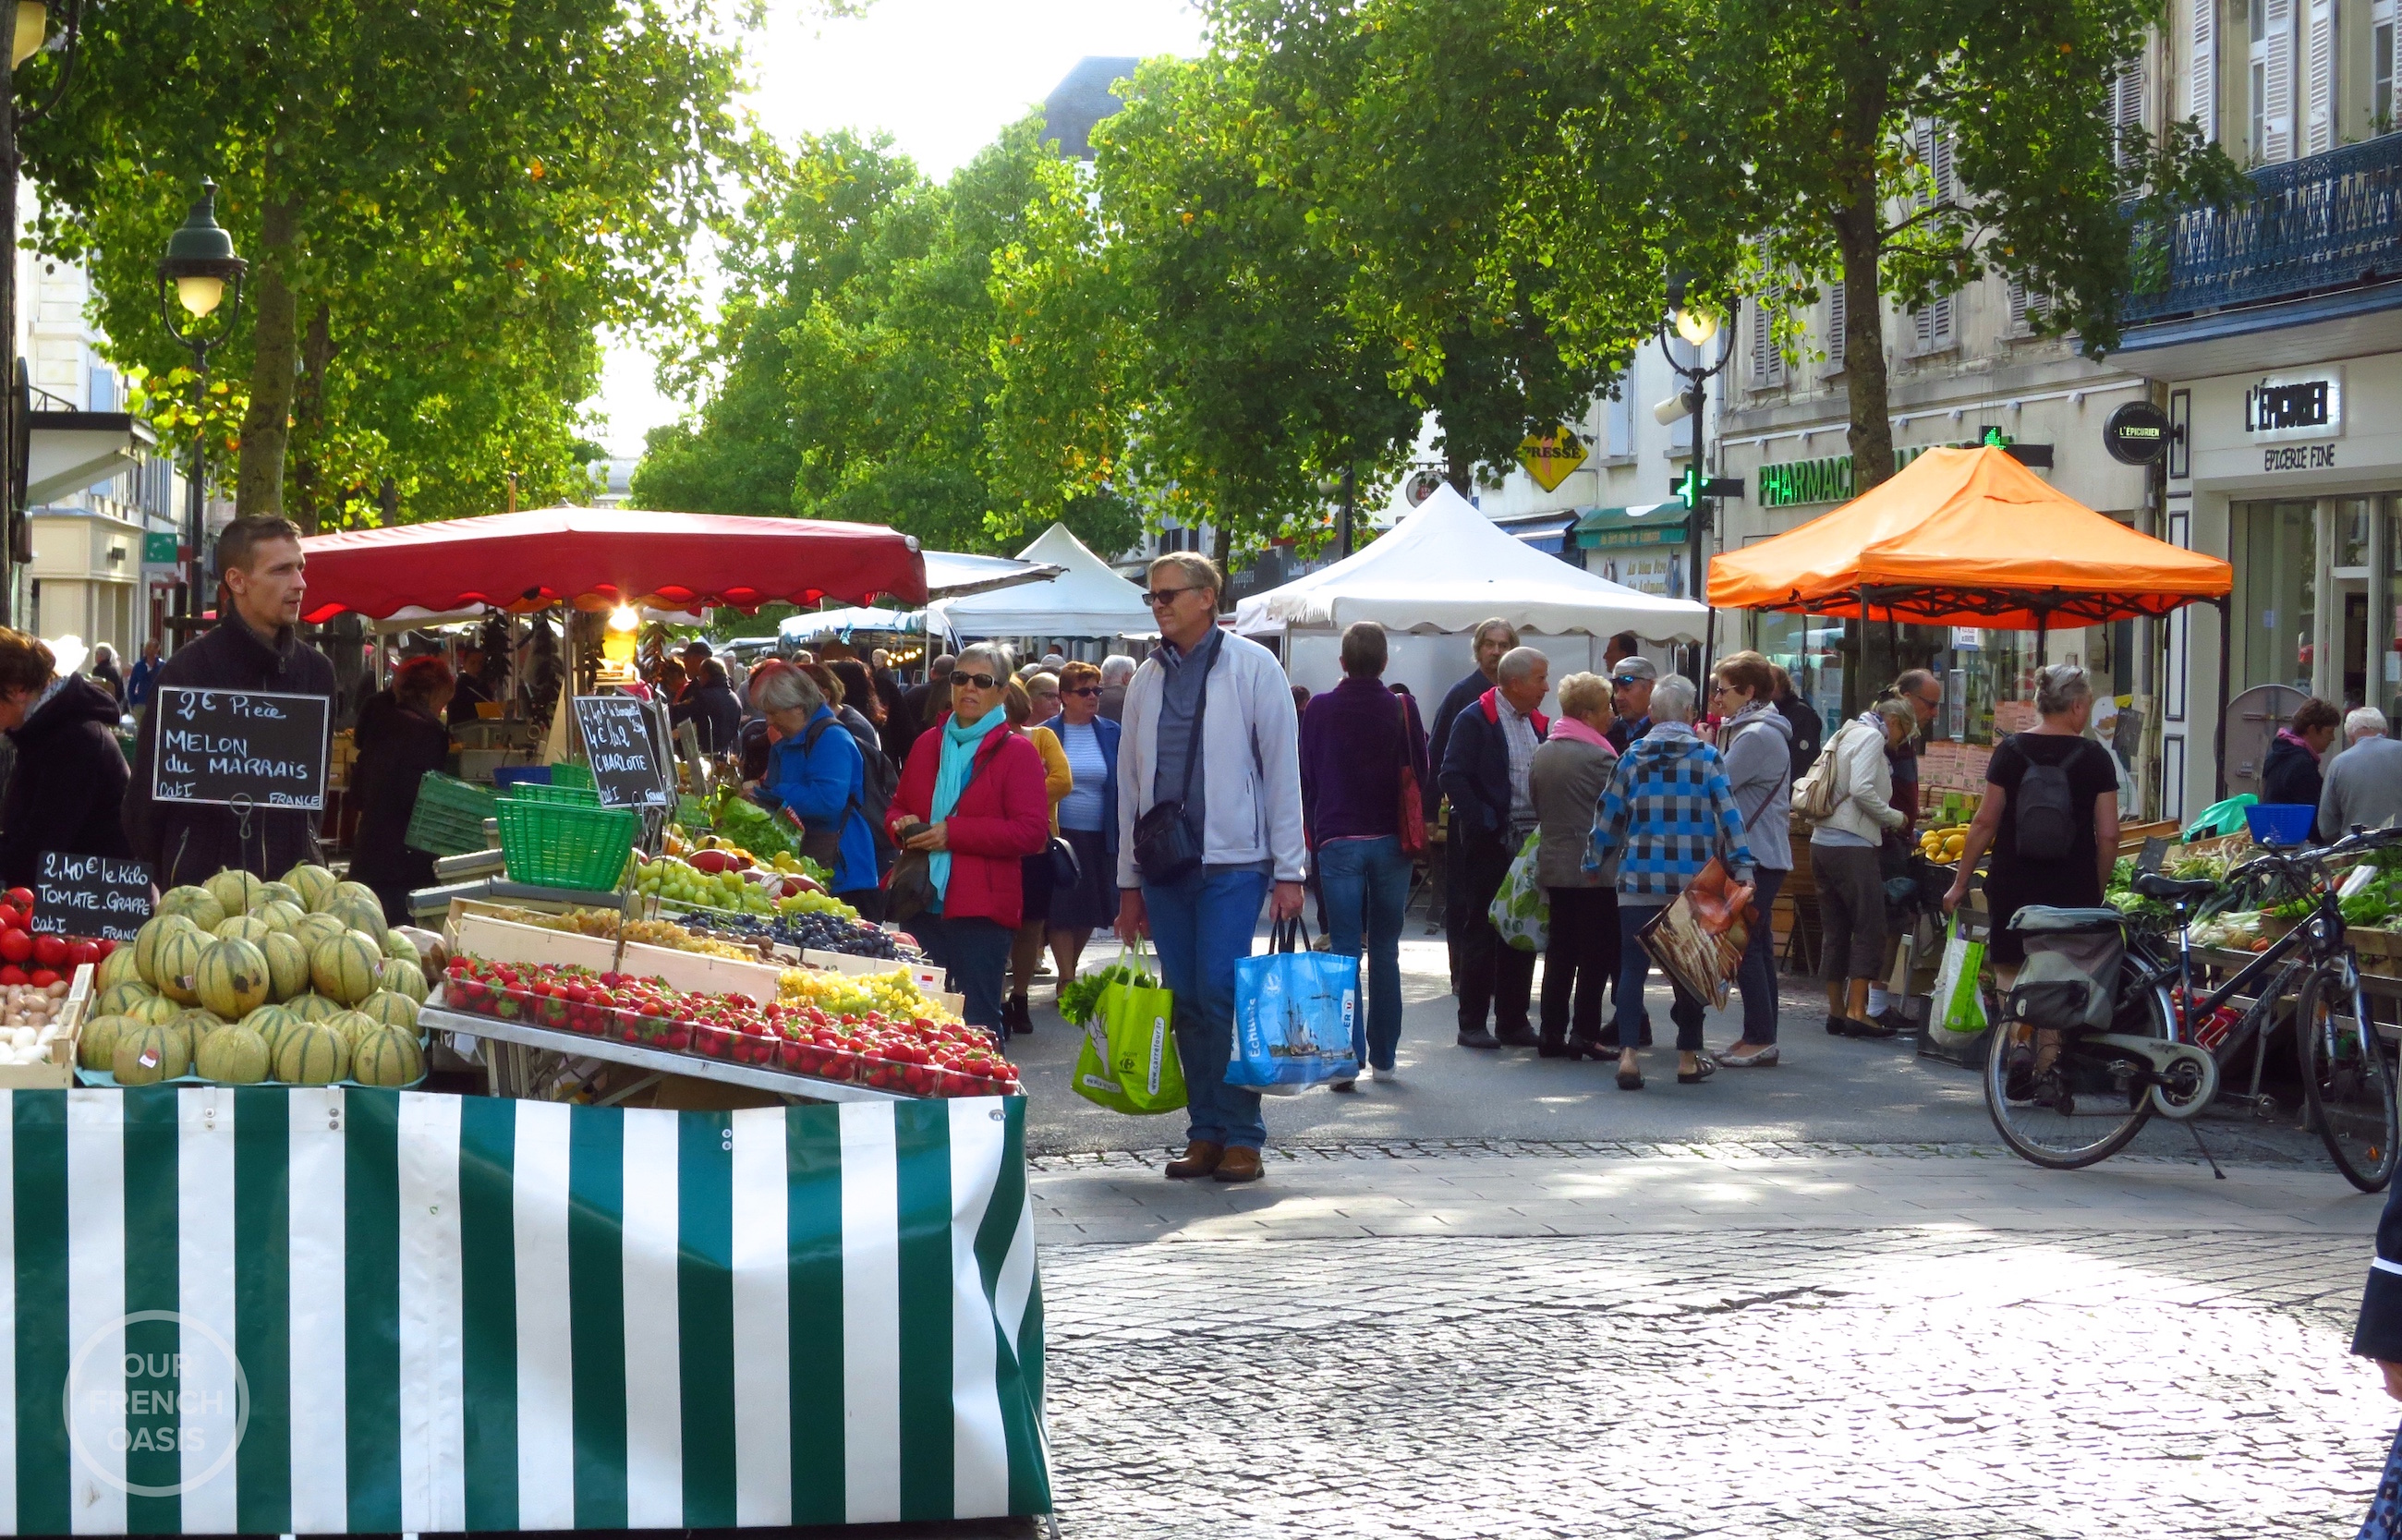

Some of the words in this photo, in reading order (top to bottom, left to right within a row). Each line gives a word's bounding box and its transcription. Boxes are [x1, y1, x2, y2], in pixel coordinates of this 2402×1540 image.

[2264, 446, 2307, 472] EPICERIE
[2310, 443, 2335, 467] FINE
[1758, 455, 1855, 507] PHARMACI
[164, 729, 249, 758] MELON
[164, 754, 196, 774] du
[594, 752, 648, 773] CHARLOTTE
[269, 791, 321, 806] FRANCE
[102, 925, 140, 940] FRANC
